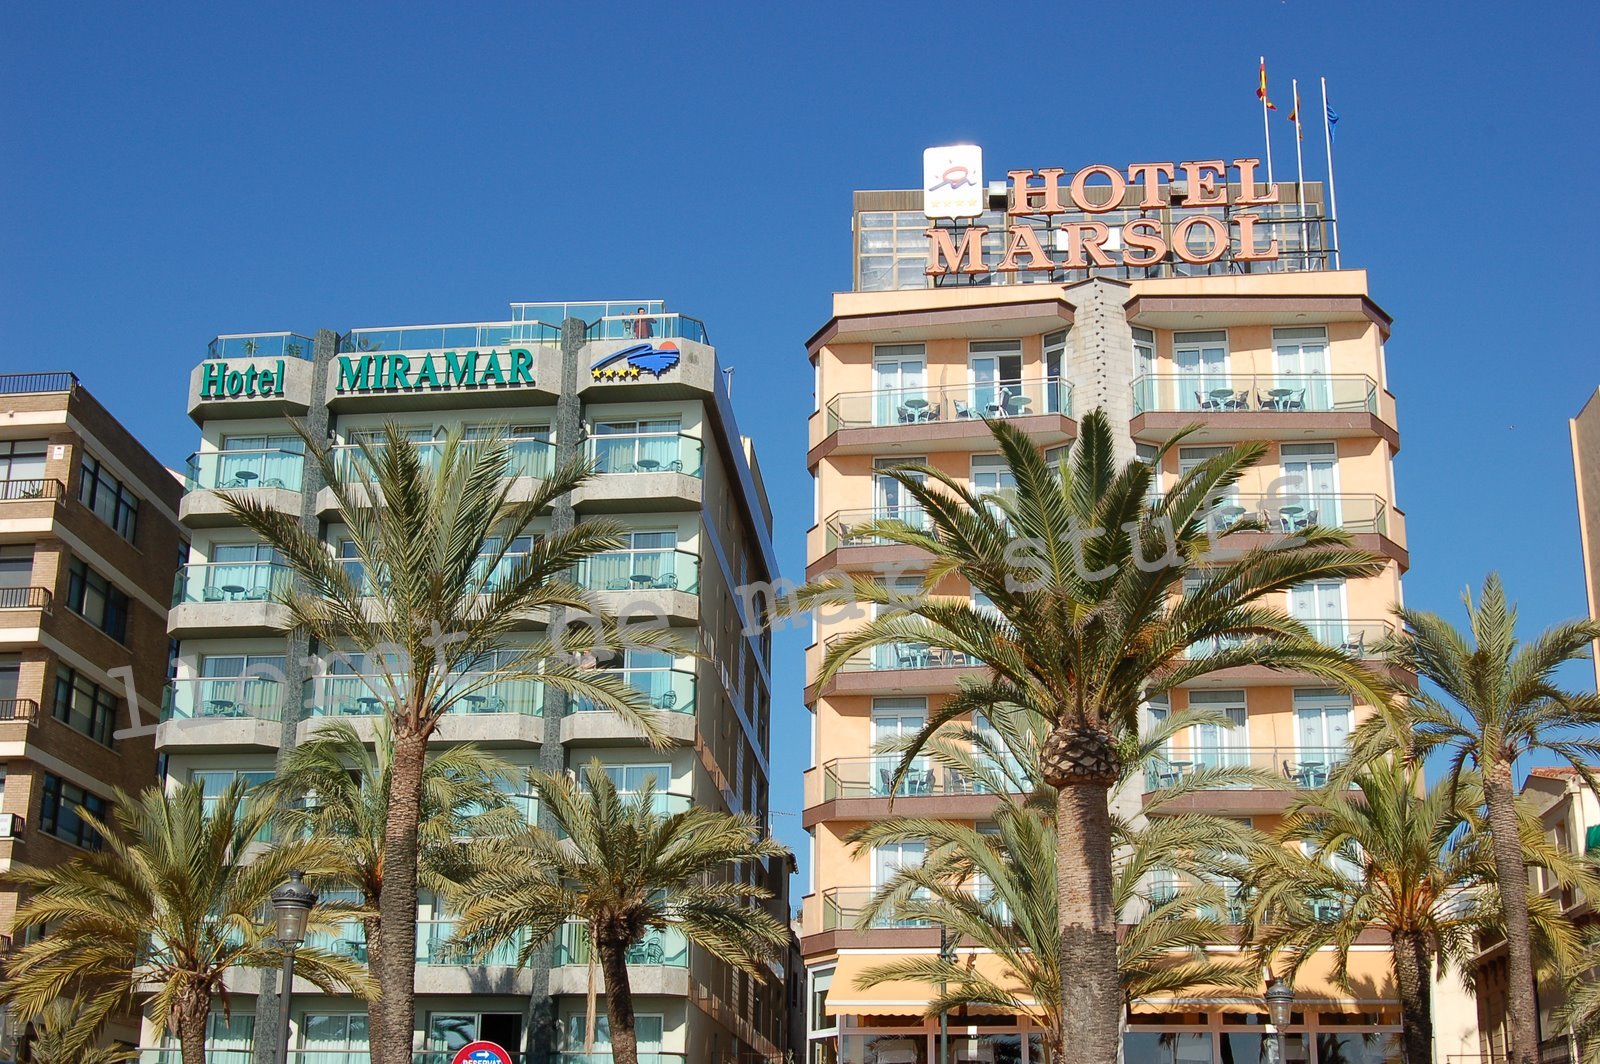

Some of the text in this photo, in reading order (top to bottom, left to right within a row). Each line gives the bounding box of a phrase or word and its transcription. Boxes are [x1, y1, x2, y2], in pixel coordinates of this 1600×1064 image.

[1007, 157, 1279, 216] HOTEL
[925, 213, 1279, 275] MARSOL
[200, 348, 535, 398] Hotel MIRAMAR
